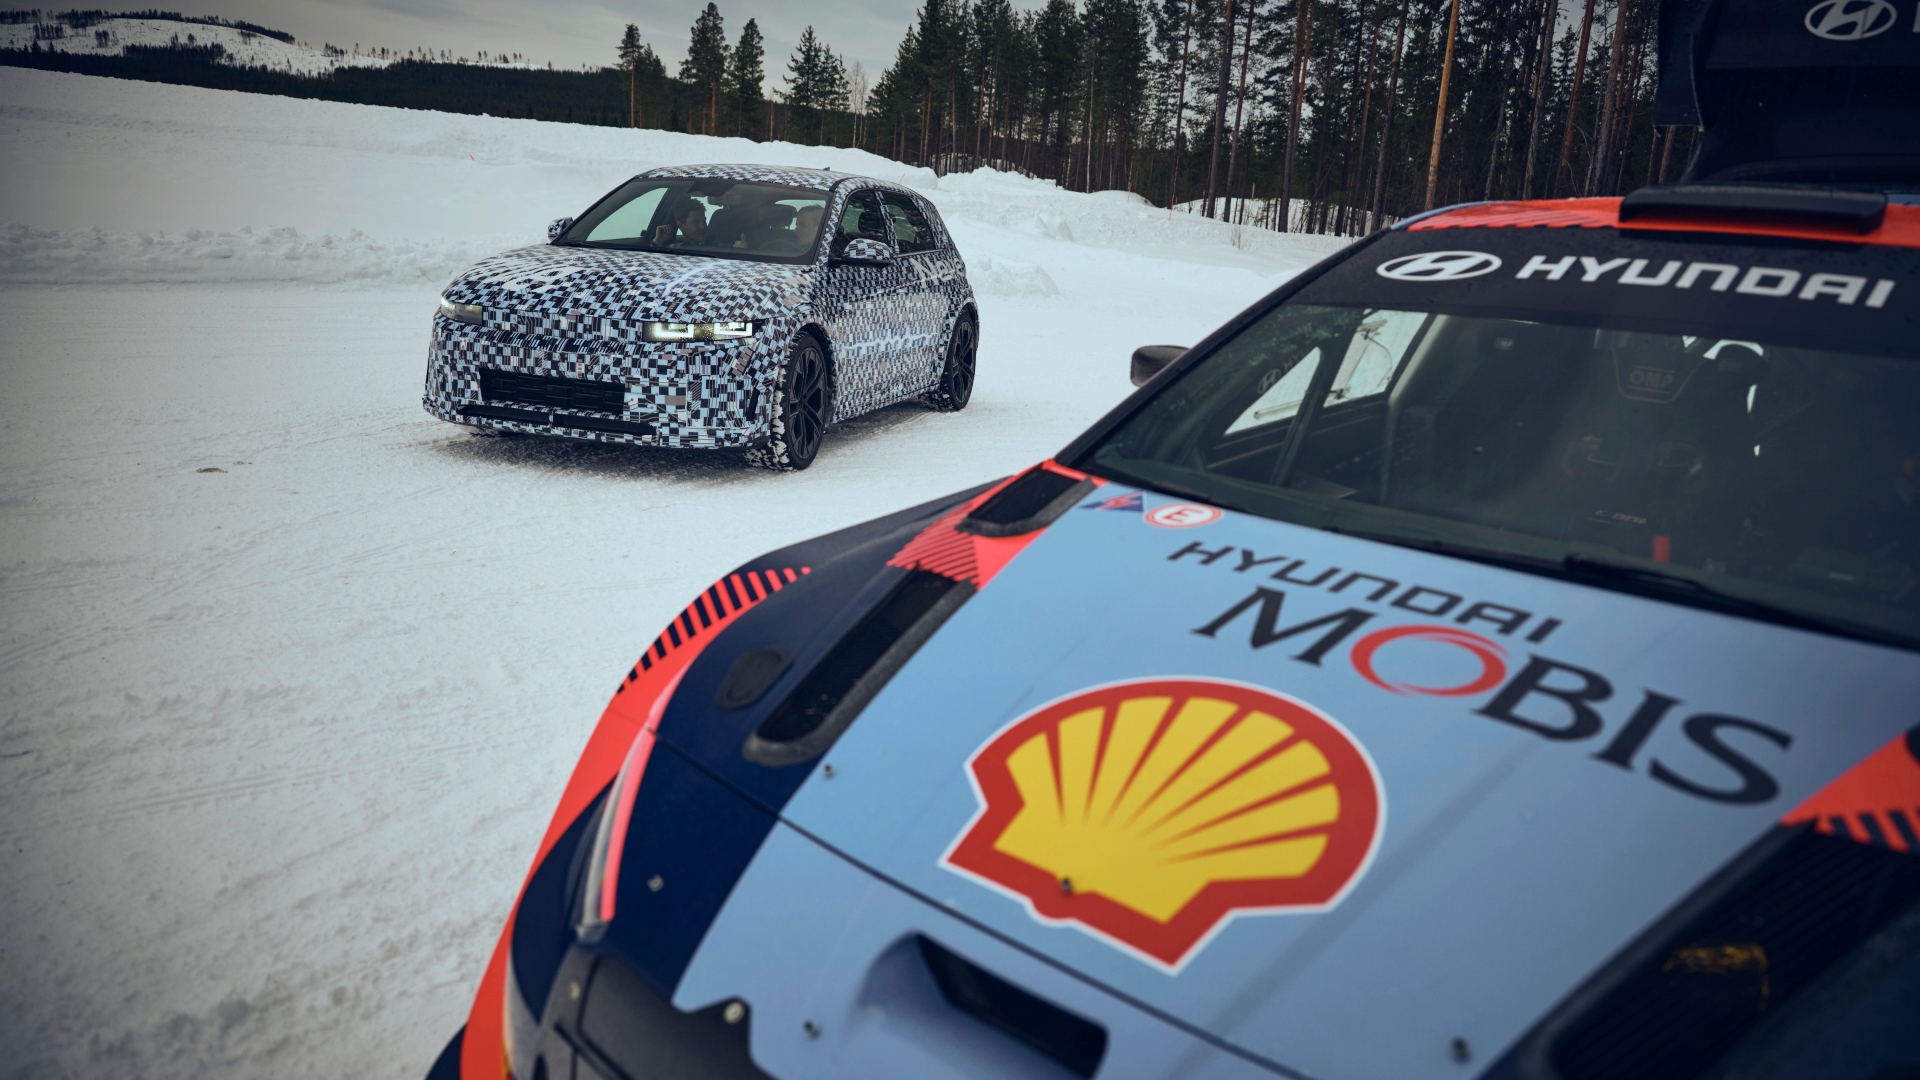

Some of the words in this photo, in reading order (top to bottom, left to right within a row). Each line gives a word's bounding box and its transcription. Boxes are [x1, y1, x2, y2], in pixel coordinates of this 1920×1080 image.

[1515, 254, 1895, 308] HYUNDAI
[1630, 369, 1674, 389] OMP
[1166, 541, 1563, 643] HYUNDAI
[1190, 584, 1795, 806] MOBIS
